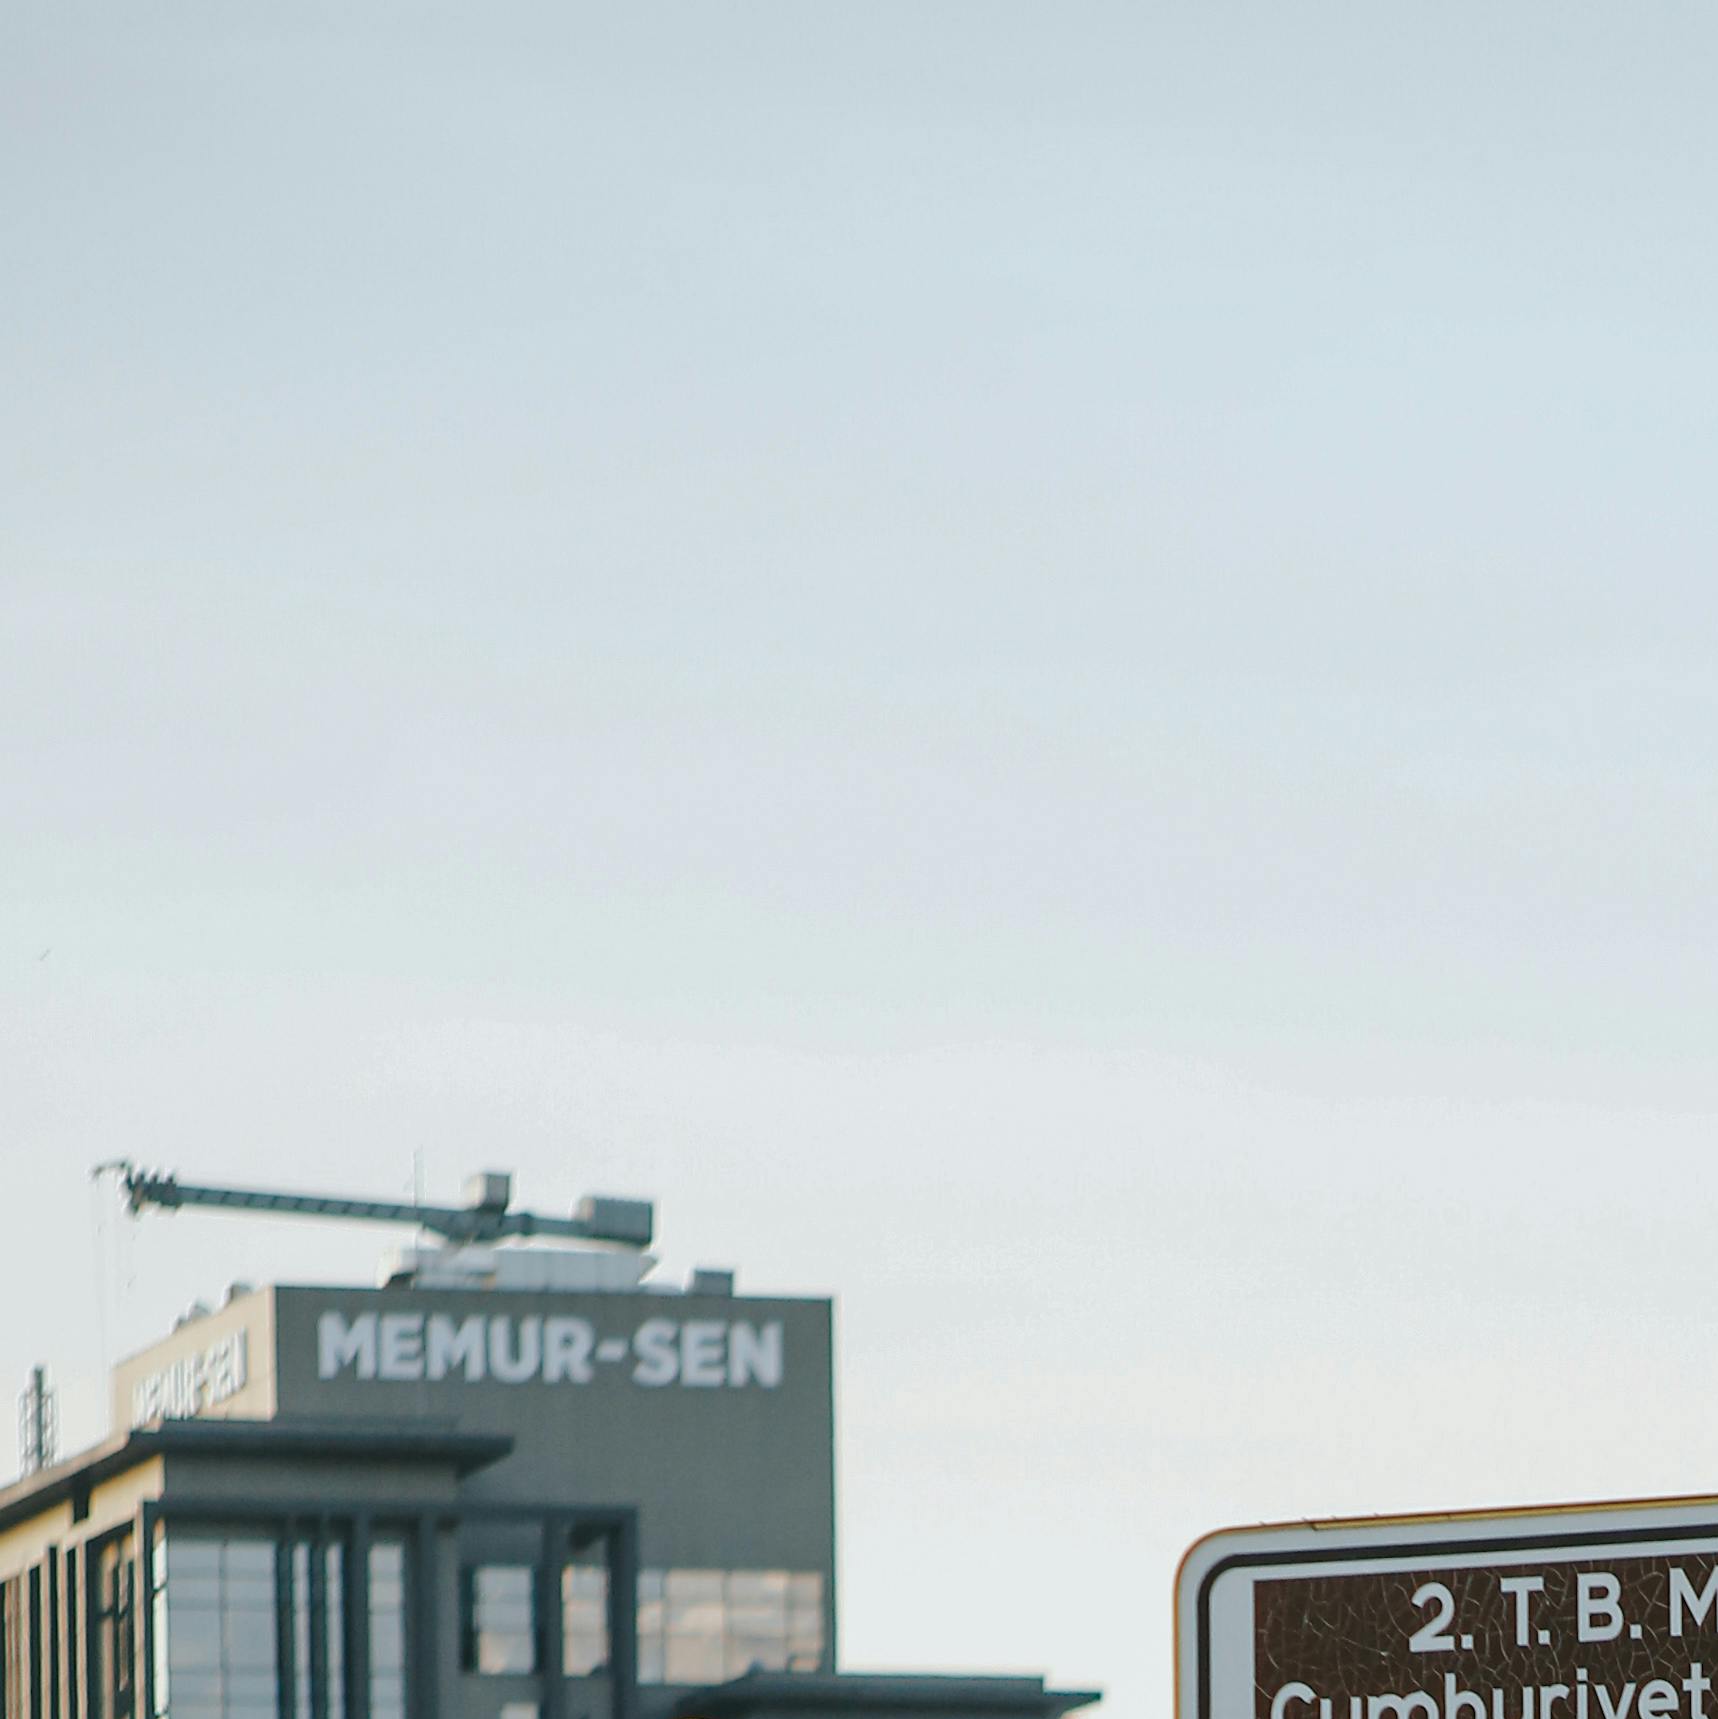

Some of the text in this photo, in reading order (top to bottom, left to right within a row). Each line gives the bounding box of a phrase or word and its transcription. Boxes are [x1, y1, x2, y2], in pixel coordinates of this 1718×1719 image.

[317, 1309, 785, 1388] MEMUR-SEN
[1408, 1582, 1473, 1652] 2.
[1501, 1575, 1552, 1646] T.
[1577, 1568, 1642, 1642] B.
